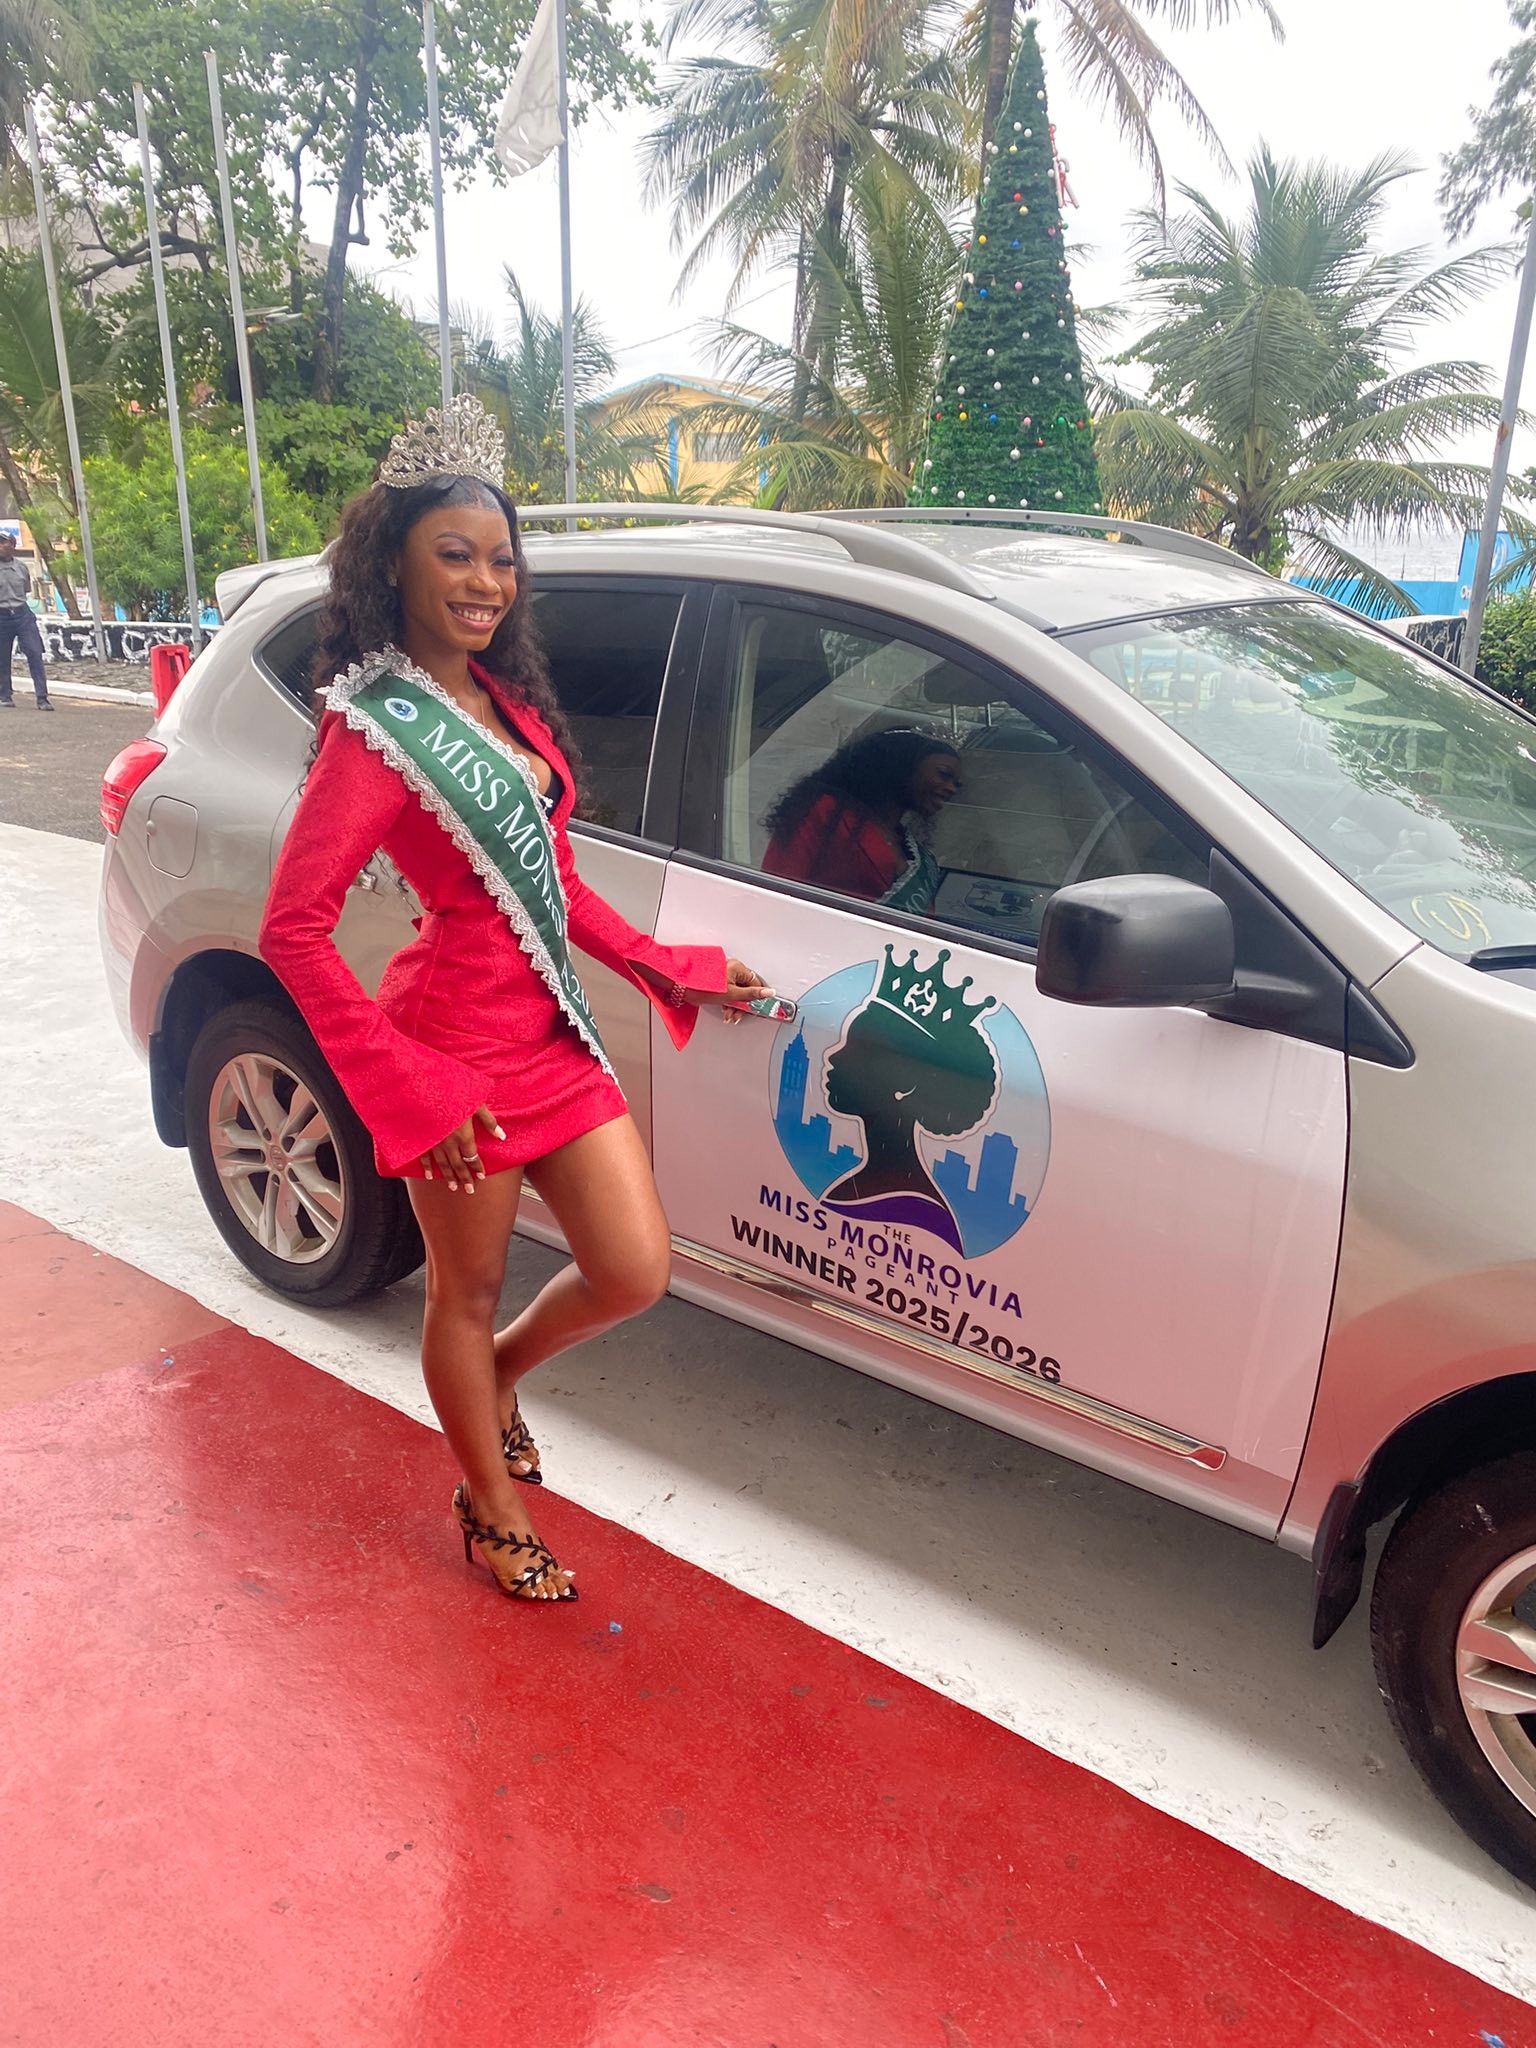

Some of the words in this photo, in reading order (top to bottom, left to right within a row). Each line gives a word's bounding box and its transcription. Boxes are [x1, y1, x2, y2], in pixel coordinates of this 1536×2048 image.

[418, 720, 511, 813] MISS
[759, 1184, 828, 1231] MISS
[840, 1220, 1023, 1319] MONROVIA
[827, 1237, 960, 1305] PAGEANT
[883, 1224, 911, 1245] THE
[730, 1214, 857, 1295] WINNER
[865, 1278, 1062, 1385] 2025/2026
